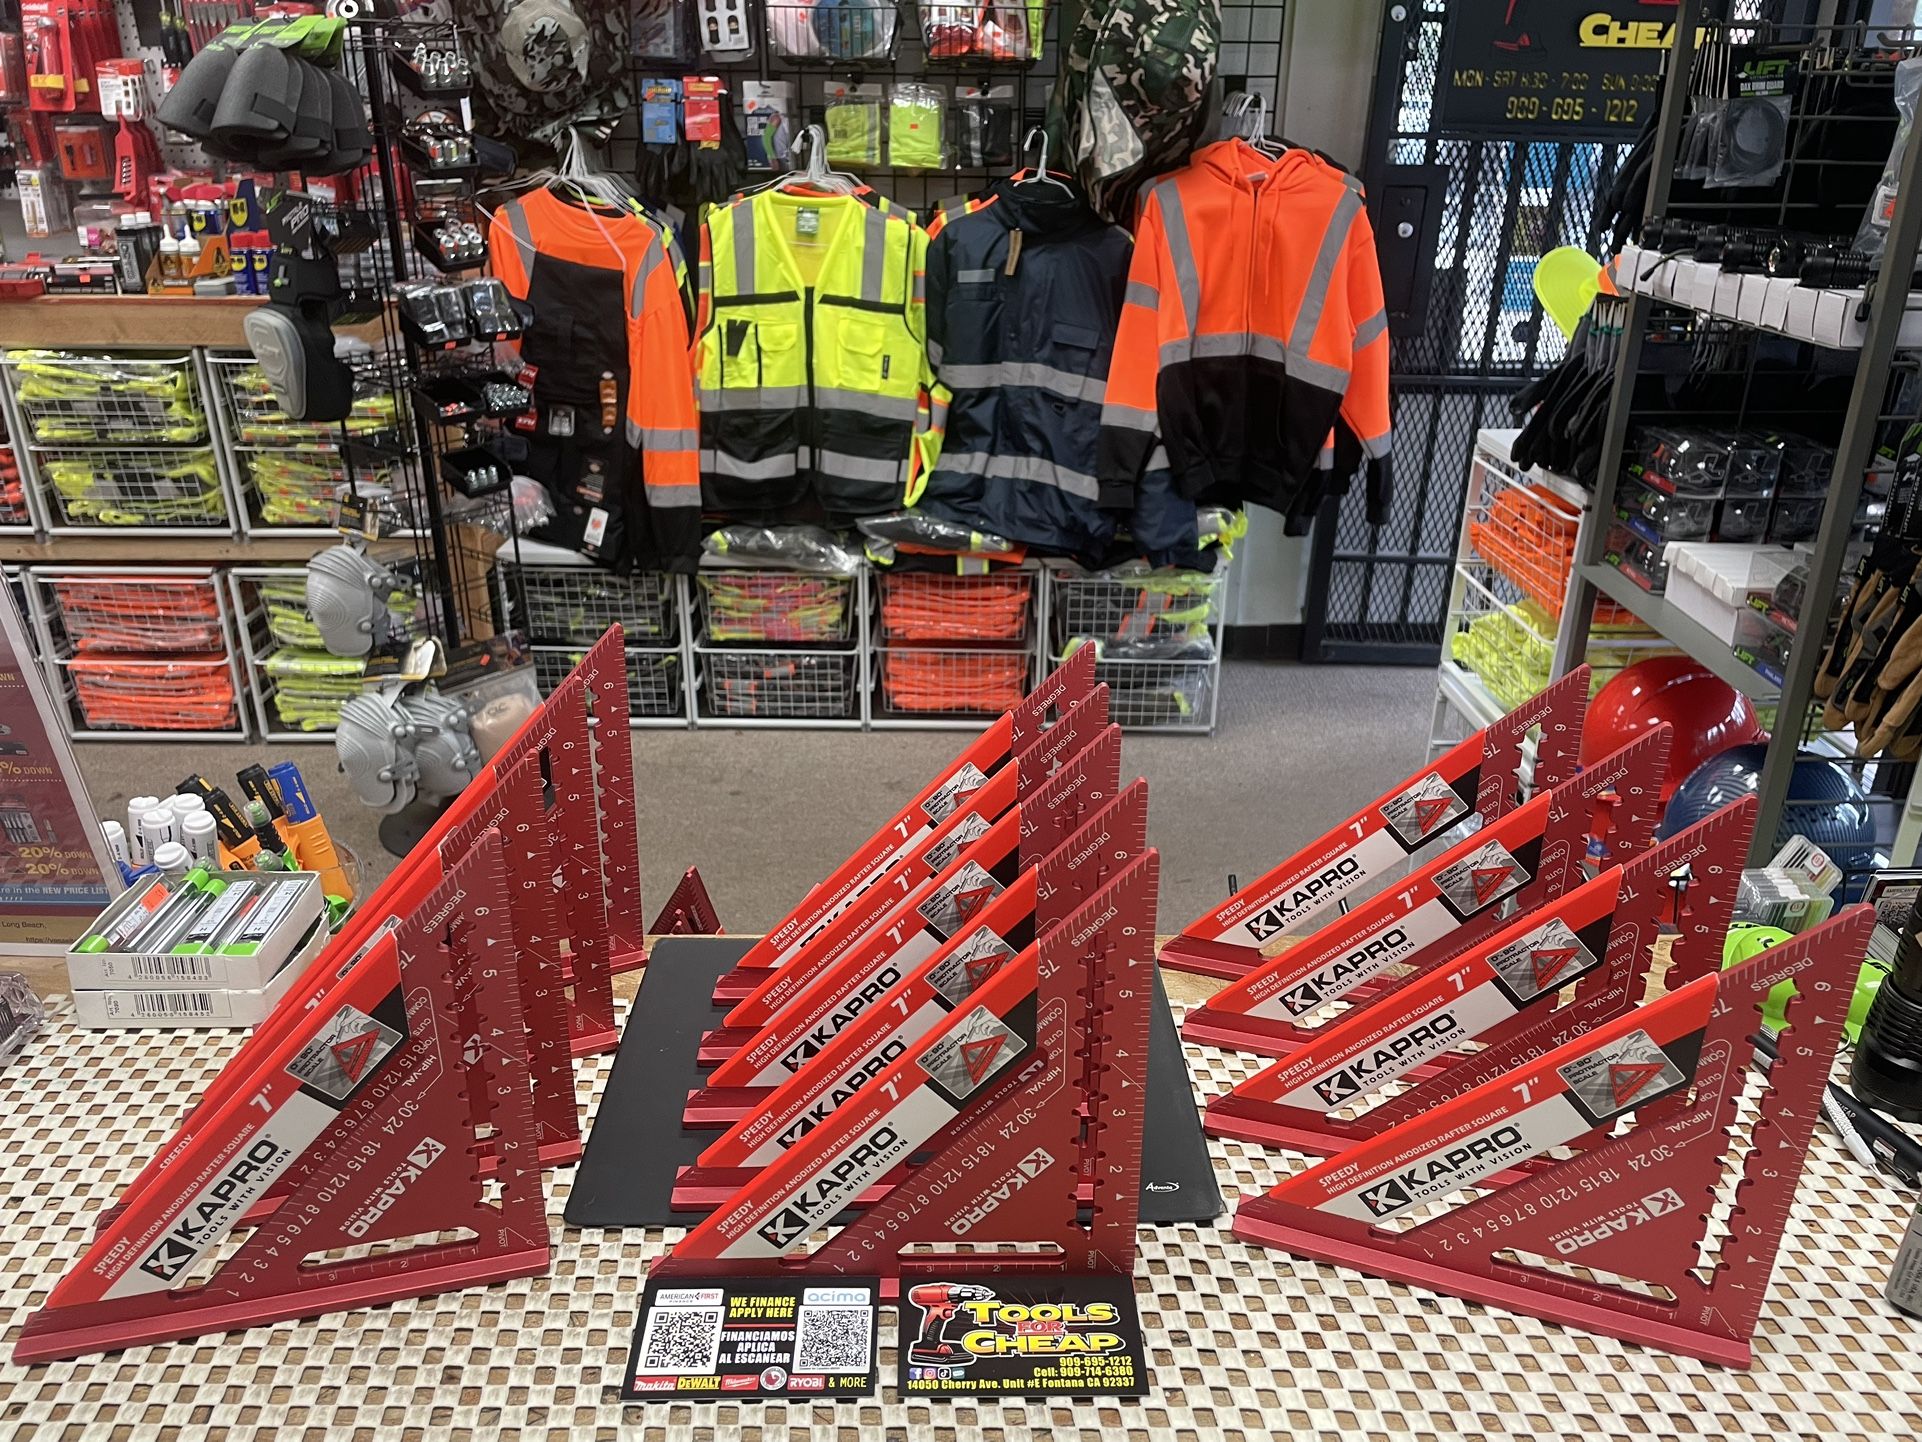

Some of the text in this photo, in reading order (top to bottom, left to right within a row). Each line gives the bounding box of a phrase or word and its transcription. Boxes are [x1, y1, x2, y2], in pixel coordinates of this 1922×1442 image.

[1453, 69, 1484, 87] MON
[1602, 73, 1626, 91] SUN
[1744, 60, 1792, 75] LIFT
[1735, 648, 1756, 665] LIFT
[1512, 705, 1552, 736] DEGREES
[23, 767, 52, 776] DOWN
[1582, 767, 1628, 800] DEGREES
[20, 846, 93, 860] 20% DOWN
[1654, 844, 1708, 878] DEGREES
[25, 863, 99, 876] 20% DOWN
[13, 886, 22, 894] in
[24, 886, 40, 894] the
[42, 886, 61, 894] NEW
[64, 886, 88, 894] PRICE
[91, 887, 109, 895] LIST
[1273, 856, 1359, 917] KAPRO
[1285, 869, 1367, 924] TOOLS WITH VISION
[422, 889, 467, 934] DEGREES
[1216, 898, 1246, 922] SPEEDY
[1072, 906, 1118, 948] DEGREES
[1310, 928, 1408, 991] KAPRO
[1324, 941, 1416, 998] TOOLS WITH VISION
[1751, 956, 1815, 993] DEGREES
[1246, 971, 1280, 995] SPEEDY
[810, 966, 902, 1048] KAPRO
[746, 1033, 779, 1064] SPEEDY
[1348, 1012, 1459, 1080] KAPRO
[1362, 1028, 1466, 1087] TOOLS WITH VISION
[400, 1054, 436, 1088] HIP-VAL
[808, 1038, 908, 1124] KAPRO
[1025, 1066, 1062, 1096] HIP-VAL
[1278, 1056, 1314, 1082] SPEEDY
[1568, 1053, 1620, 1080] PROTRACTOR
[1573, 1071, 1600, 1086] SCALE
[249, 1083, 273, 1114] 7"
[880, 1072, 902, 1103] 7"
[1512, 1076, 1540, 1104] 7"
[739, 1110, 775, 1143] SPEEDY
[1665, 1109, 1713, 1133] HIP-VAL
[1326, 1106, 1510, 1195] HIGH DEFINITION ANODIZED RAFTER SQUARE
[1398, 1125, 1524, 1182] KAPRO
[726, 1108, 882, 1240] HIGH DEFINITION ANODIZED RAFTER SQUARE
[792, 1126, 898, 1215] KAPRO
[810, 1138, 909, 1222] TOOLS WITH VISION
[1318, 1162, 1360, 1188] SPEEDY
[1414, 1143, 1532, 1200] TOOLS WITH VISION
[105, 1122, 256, 1280] HIGH DEFINITION ANODIZED RAFTER SQUARE
[174, 1138, 281, 1242] KAPRO
[196, 1148, 293, 1246] TOOLS WITH VISION
[347, 1165, 424, 1238] KAPRO
[952, 1170, 1030, 1236] KAPRO
[716, 1200, 754, 1234] SPEEDY
[1555, 1214, 1653, 1256] KAPRO
[93, 1236, 131, 1276] SPEEDY
[701, 1292, 719, 1300] FIRST
[730, 1296, 796, 1308] WE FINANCE
[808, 1290, 866, 1302] acima
[729, 1307, 794, 1318] APPLY HERE
[964, 1302, 1119, 1323] TOOLS
[1016, 1321, 1063, 1333] FOR
[720, 1331, 795, 1342] FINANCIAMOS
[736, 1342, 776, 1352] APLICA
[963, 1331, 1120, 1354] CHEAP
[718, 1353, 790, 1364] AL ESCANEAR
[1034, 1366, 1133, 1378] Cell: 909-714-6380
[1060, 1356, 1132, 1367] 909-695-1212
[789, 1378, 824, 1388] RYOBI
[828, 1377, 867, 1388] & MORE
[907, 1376, 1134, 1392] 14050 Cherry Ave. Unit #E Fontana CA 92337
